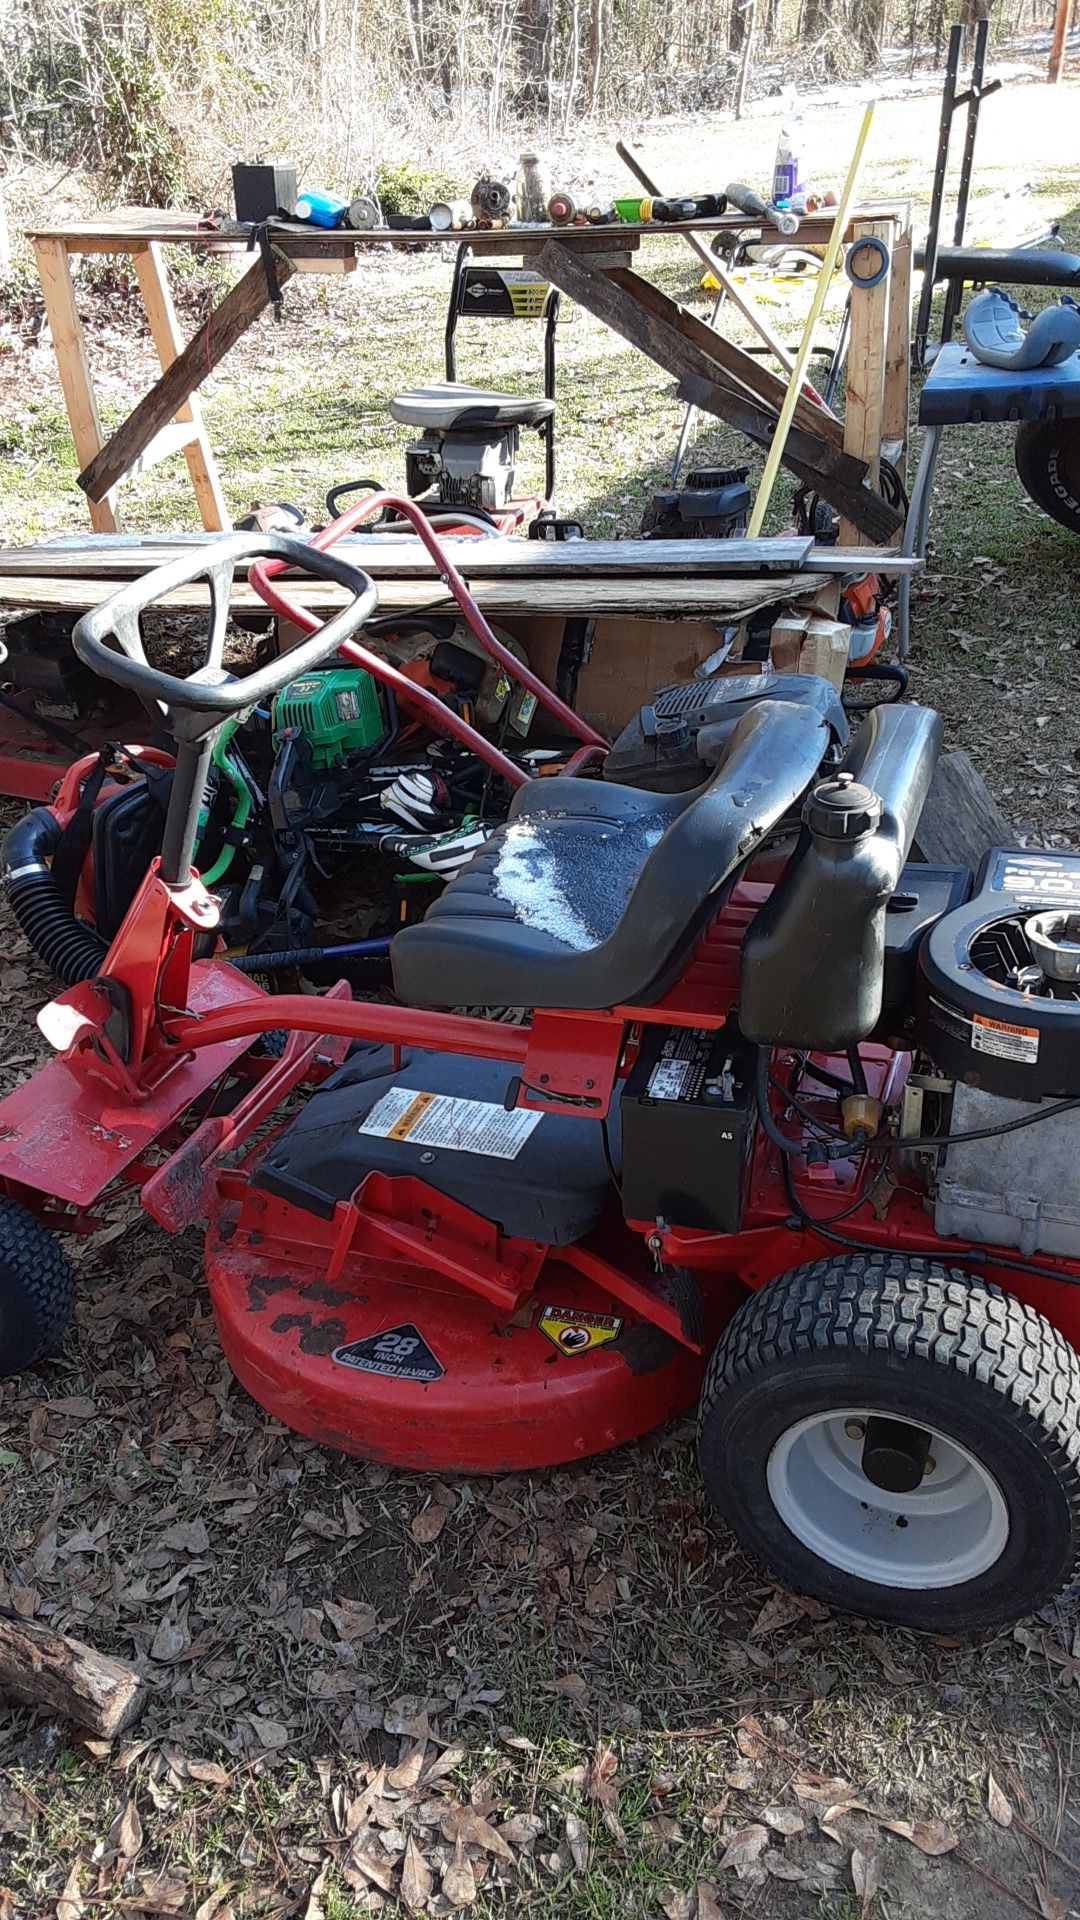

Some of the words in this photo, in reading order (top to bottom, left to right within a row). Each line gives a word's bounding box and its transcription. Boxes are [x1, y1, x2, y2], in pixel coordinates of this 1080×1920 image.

[988, 1020, 1028, 1036] WARNING
[721, 1131, 733, 1140] A5
[550, 1308, 615, 1328] DANGER
[373, 1333, 420, 1356] 28
[340, 1352, 397, 1373] PATENTED
[396, 1365, 436, 1378] HI-VAC
[373, 1351, 405, 1363] INCH
